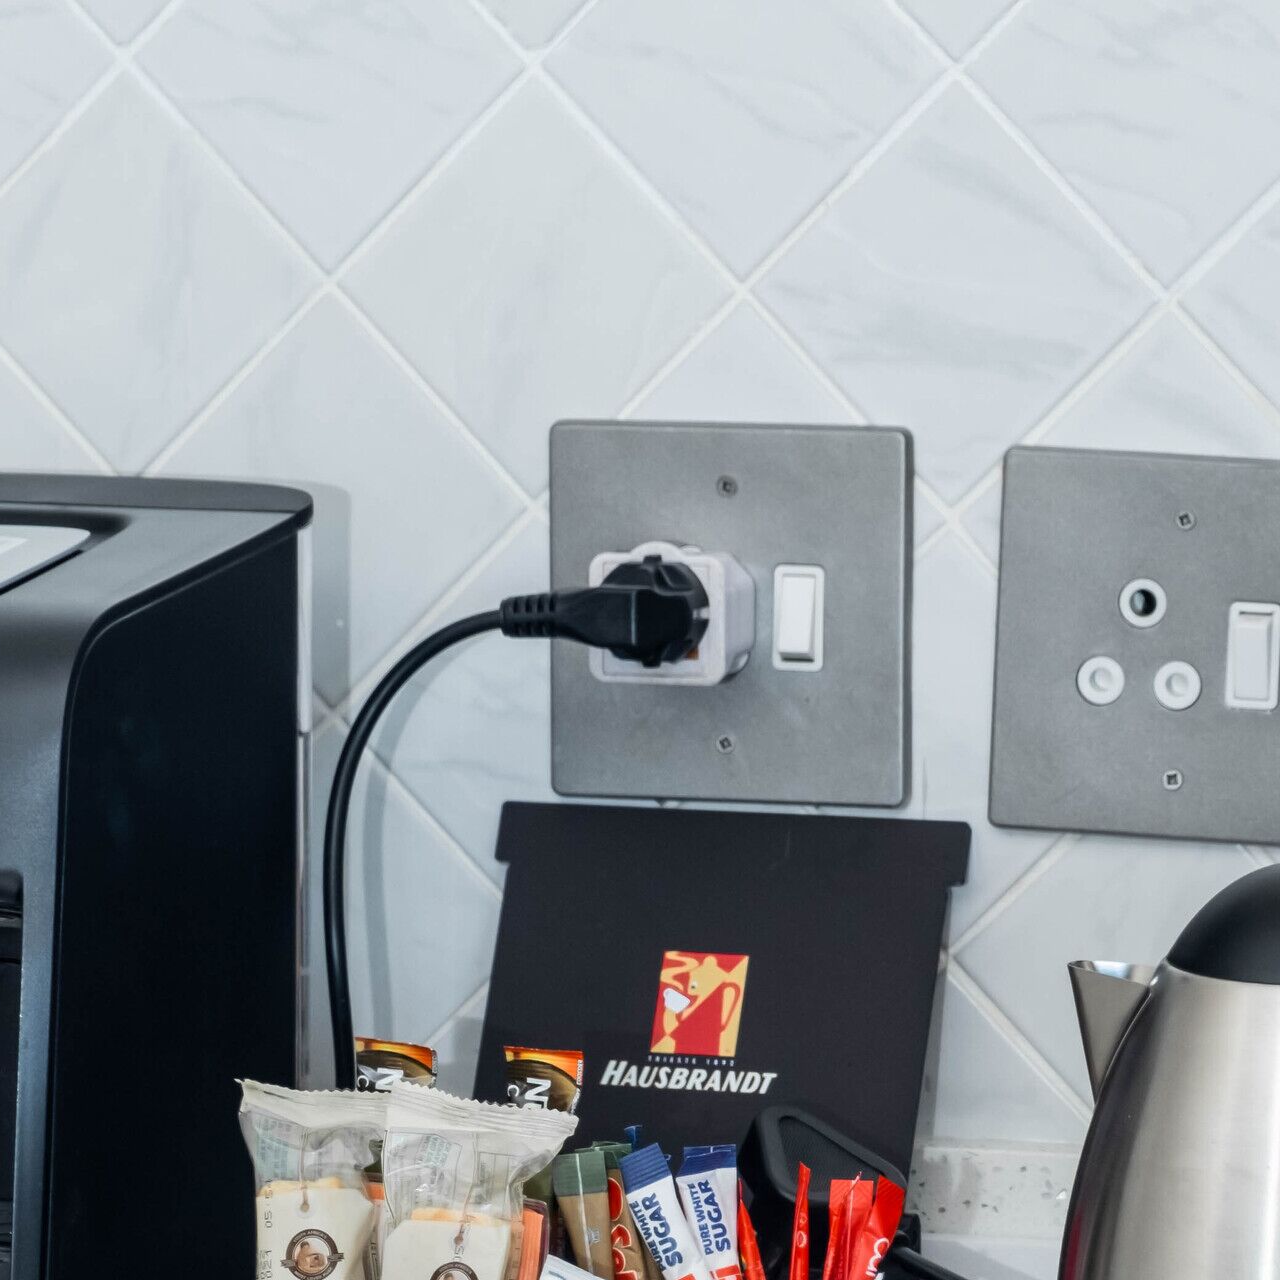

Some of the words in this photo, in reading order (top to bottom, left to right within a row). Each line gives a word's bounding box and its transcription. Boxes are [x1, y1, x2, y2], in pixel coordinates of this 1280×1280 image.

[600, 1060, 778, 1095] HAUSBRANDT
[629, 1200, 652, 1241] WHITE
[687, 1183, 706, 1223] WHITE
[698, 1180, 732, 1253] SUGAR
[641, 1192, 683, 1267] SUGAR
[698, 1223, 714, 1256] PURE
